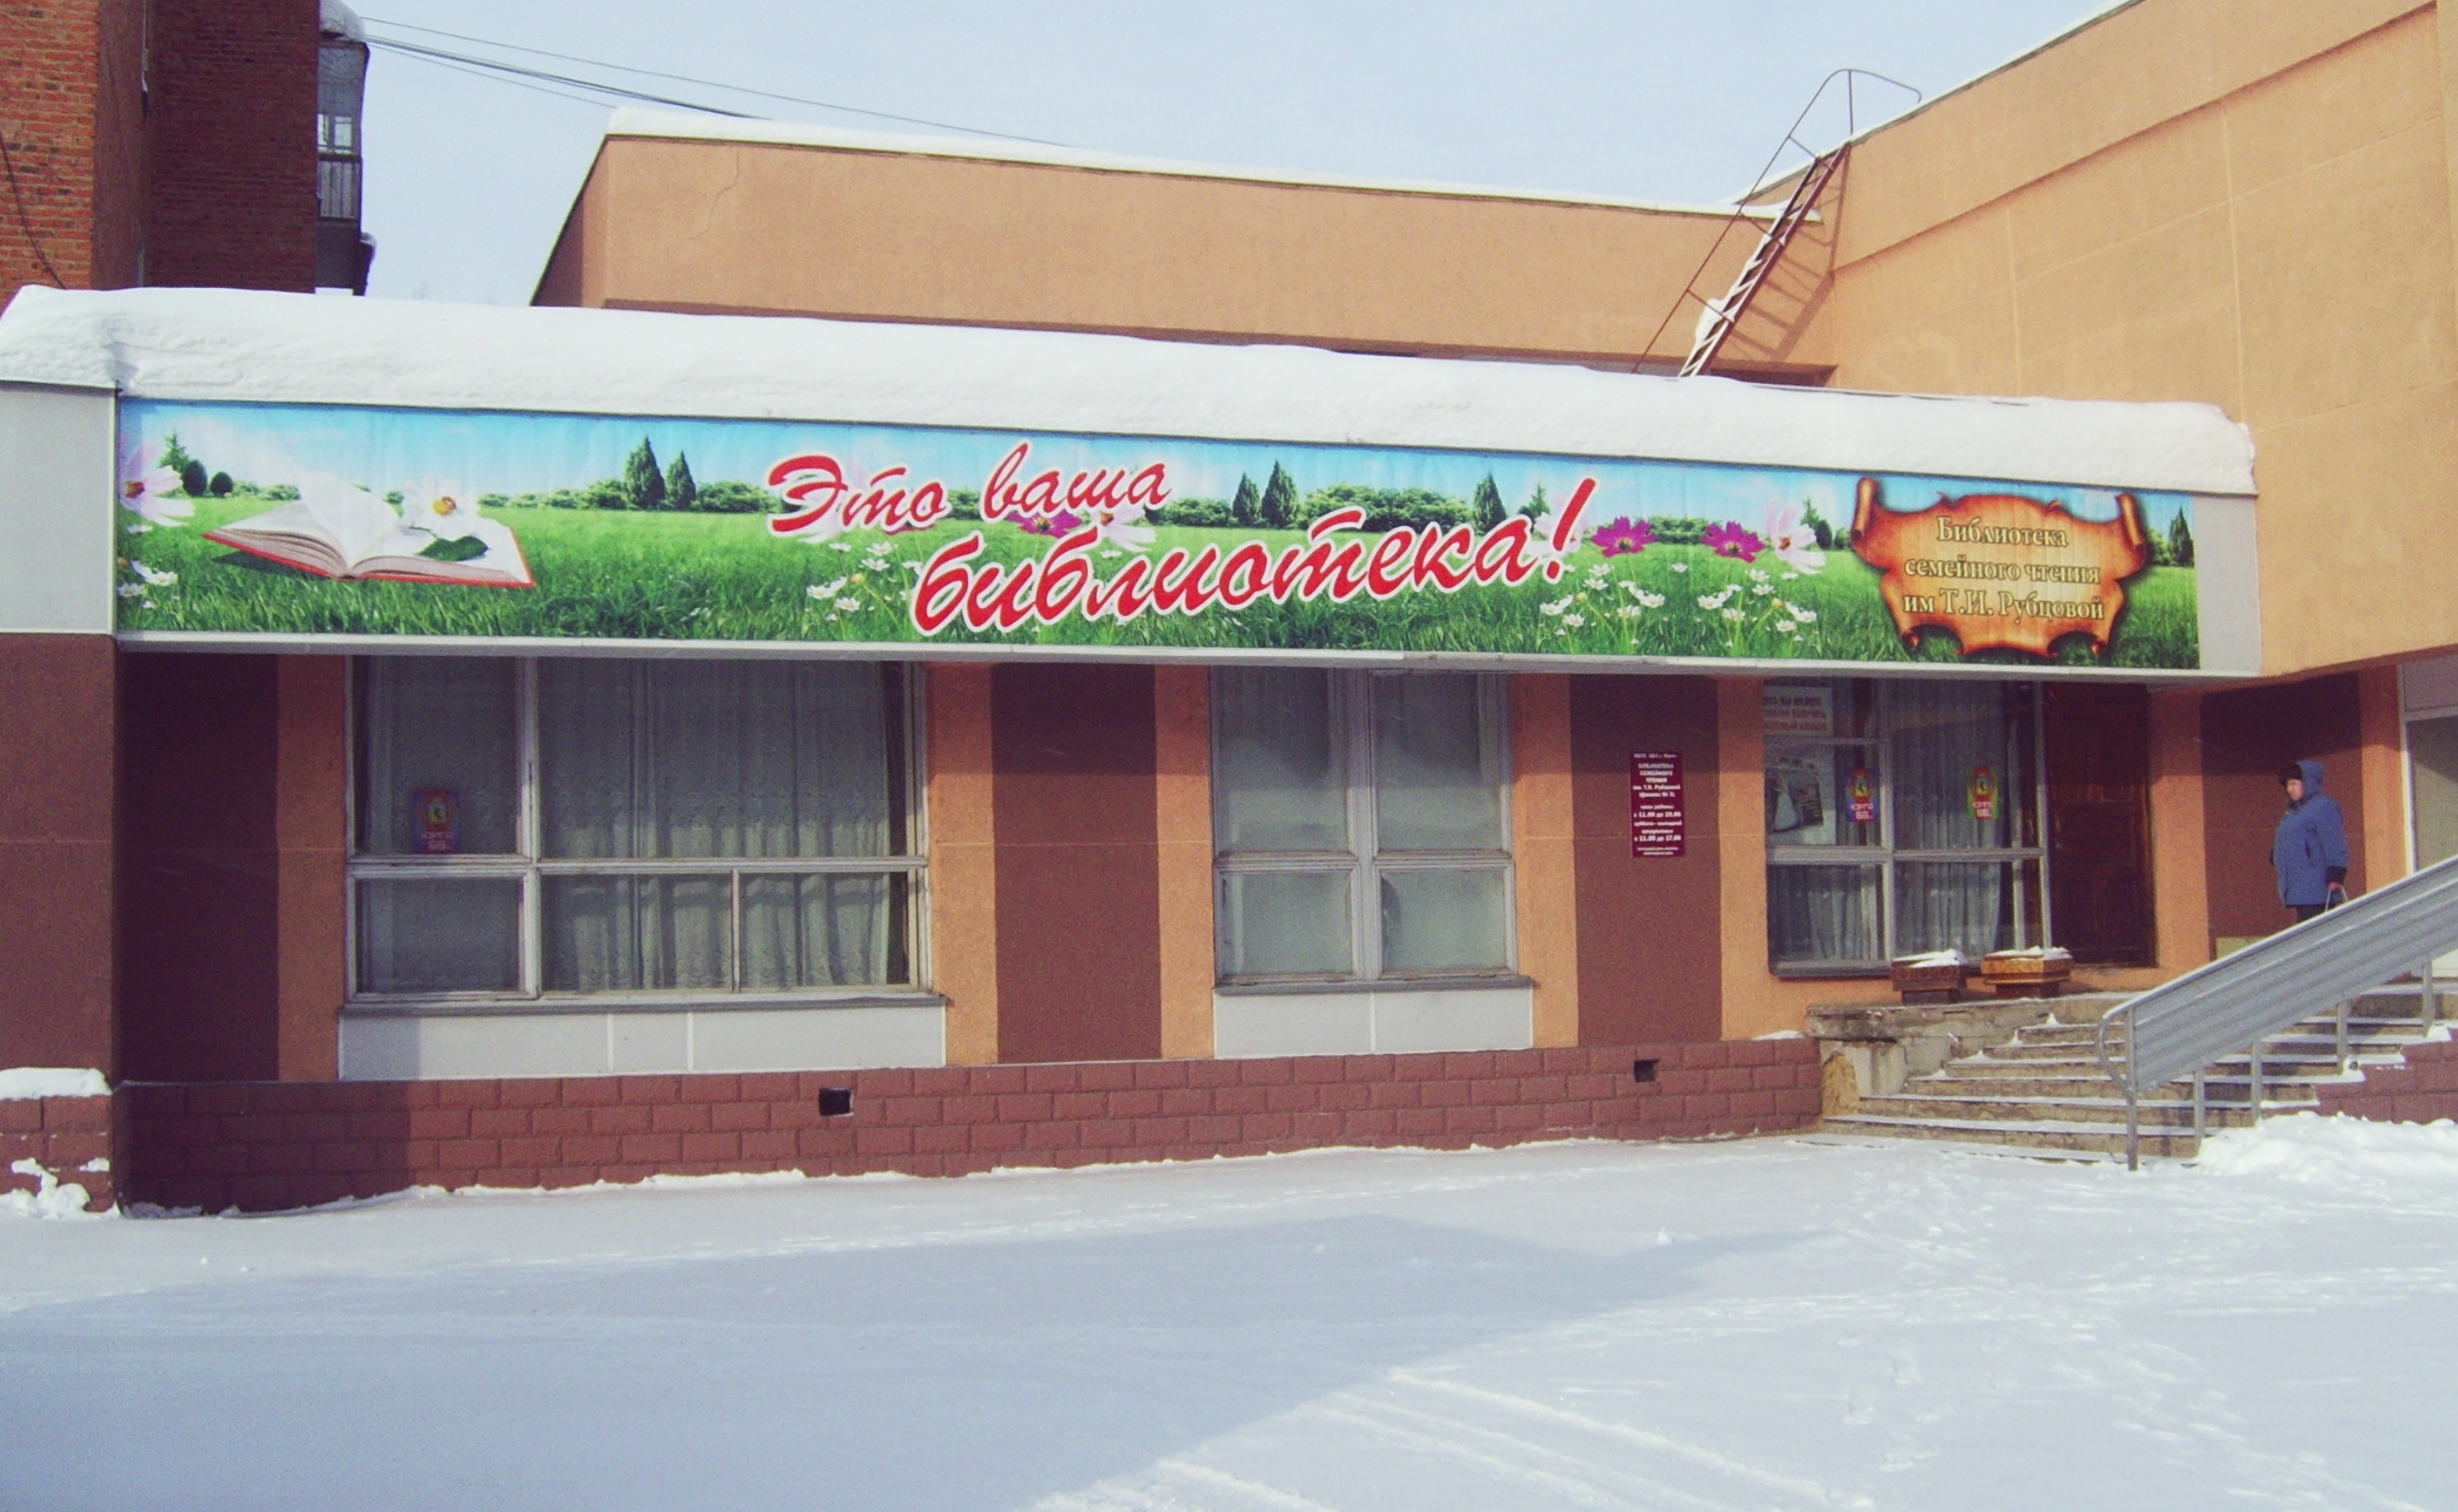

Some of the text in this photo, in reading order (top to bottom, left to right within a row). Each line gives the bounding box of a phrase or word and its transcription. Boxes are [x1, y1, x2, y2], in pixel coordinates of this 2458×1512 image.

[769, 442, 1172, 534] Это ваша
[1936, 515, 2069, 547] Библиотека
[913, 478, 1596, 632] библиотека!
[1904, 554, 2100, 584] семейного чтения
[1903, 587, 2104, 624] им Т.И. Рубцовой
